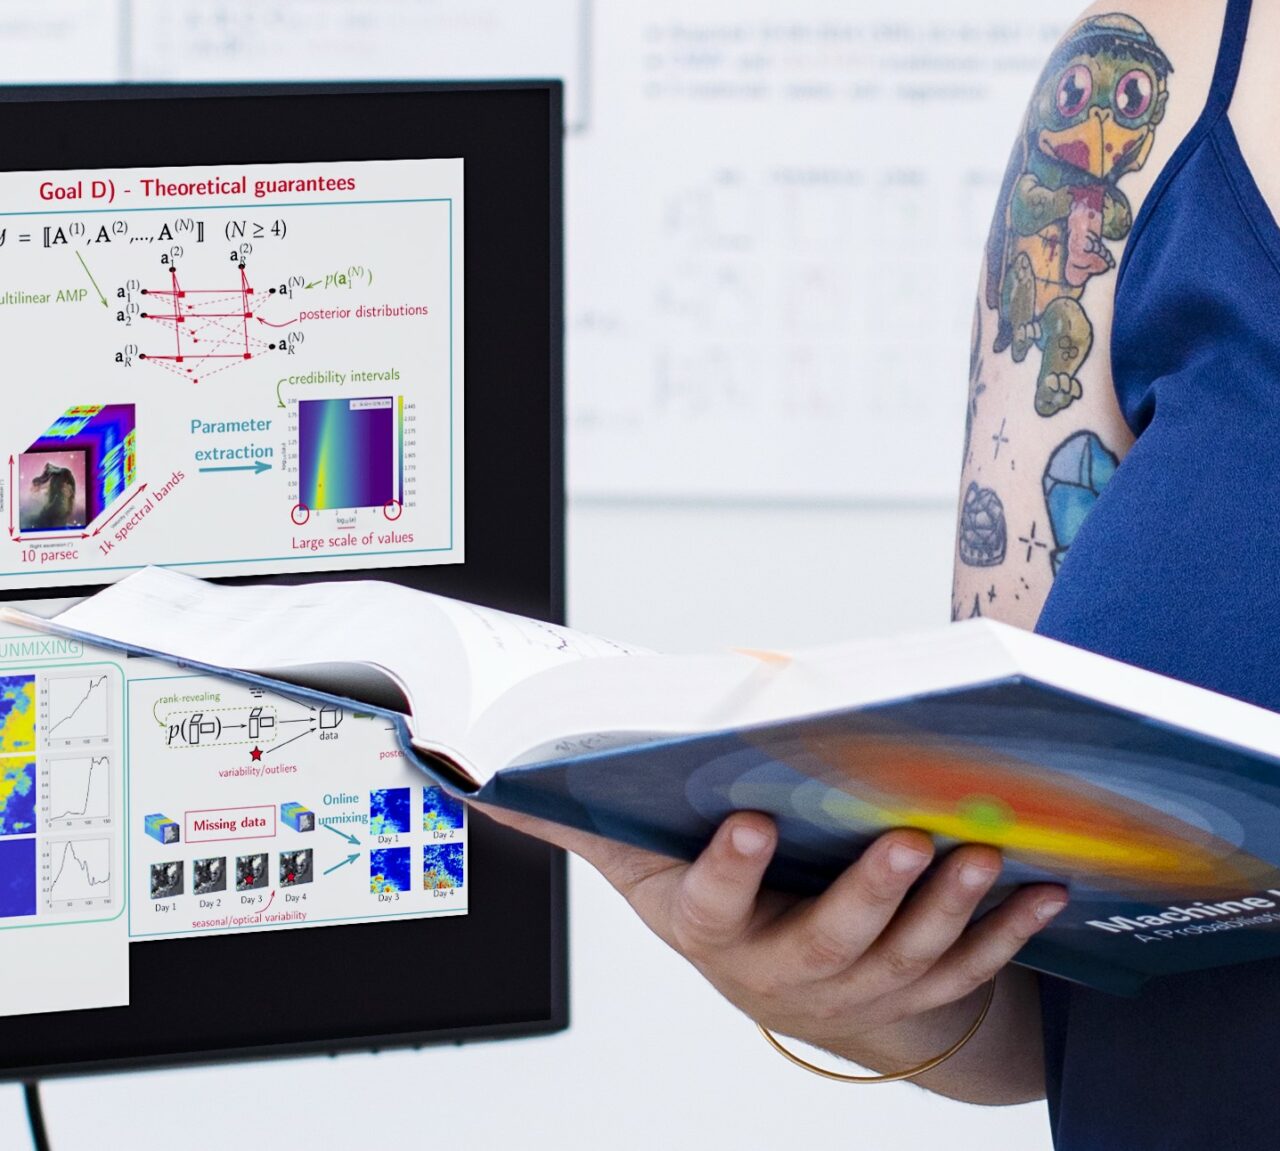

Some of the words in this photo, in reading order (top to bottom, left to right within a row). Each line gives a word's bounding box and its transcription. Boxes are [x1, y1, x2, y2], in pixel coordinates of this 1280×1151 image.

[39, 181, 82, 201] Goal
[91, 179, 116, 203] D)
[140, 176, 246, 198] Theoretical
[254, 176, 356, 198] guarantees
[56, 289, 88, 303] AMP
[300, 307, 351, 321] posterior
[355, 304, 428, 318] distributions
[288, 370, 346, 386] credibility
[351, 368, 400, 382] intervals
[191, 418, 272, 434] Parameter
[195, 443, 274, 461] extraction
[114, 498, 155, 542] spectral
[153, 469, 186, 504] bands
[292, 536, 324, 550] Large
[329, 534, 357, 547] scale
[362, 532, 374, 544] of
[378, 532, 414, 544] values
[21, 550, 36, 562] 10
[41, 549, 79, 564] parsec
[159, 691, 221, 704] rank-revealing
[319, 731, 338, 741] data
[218, 763, 297, 778] variability/outliers
[323, 793, 359, 806] Online
[193, 818, 237, 832] Missing
[240, 816, 266, 828] data
[318, 811, 368, 826] unmixing
[378, 835, 394, 845] Day
[433, 831, 449, 840] Day
[240, 896, 255, 905] Day
[285, 894, 300, 903] Day
[378, 894, 395, 903] Day
[433, 889, 449, 898] Day
[155, 903, 170, 913] Day
[199, 900, 214, 909] Day
[192, 912, 262, 928] seasonal/optical
[264, 911, 307, 923] variability
[1085, 894, 1276, 933] Machine
[1133, 932, 1161, 943] A
